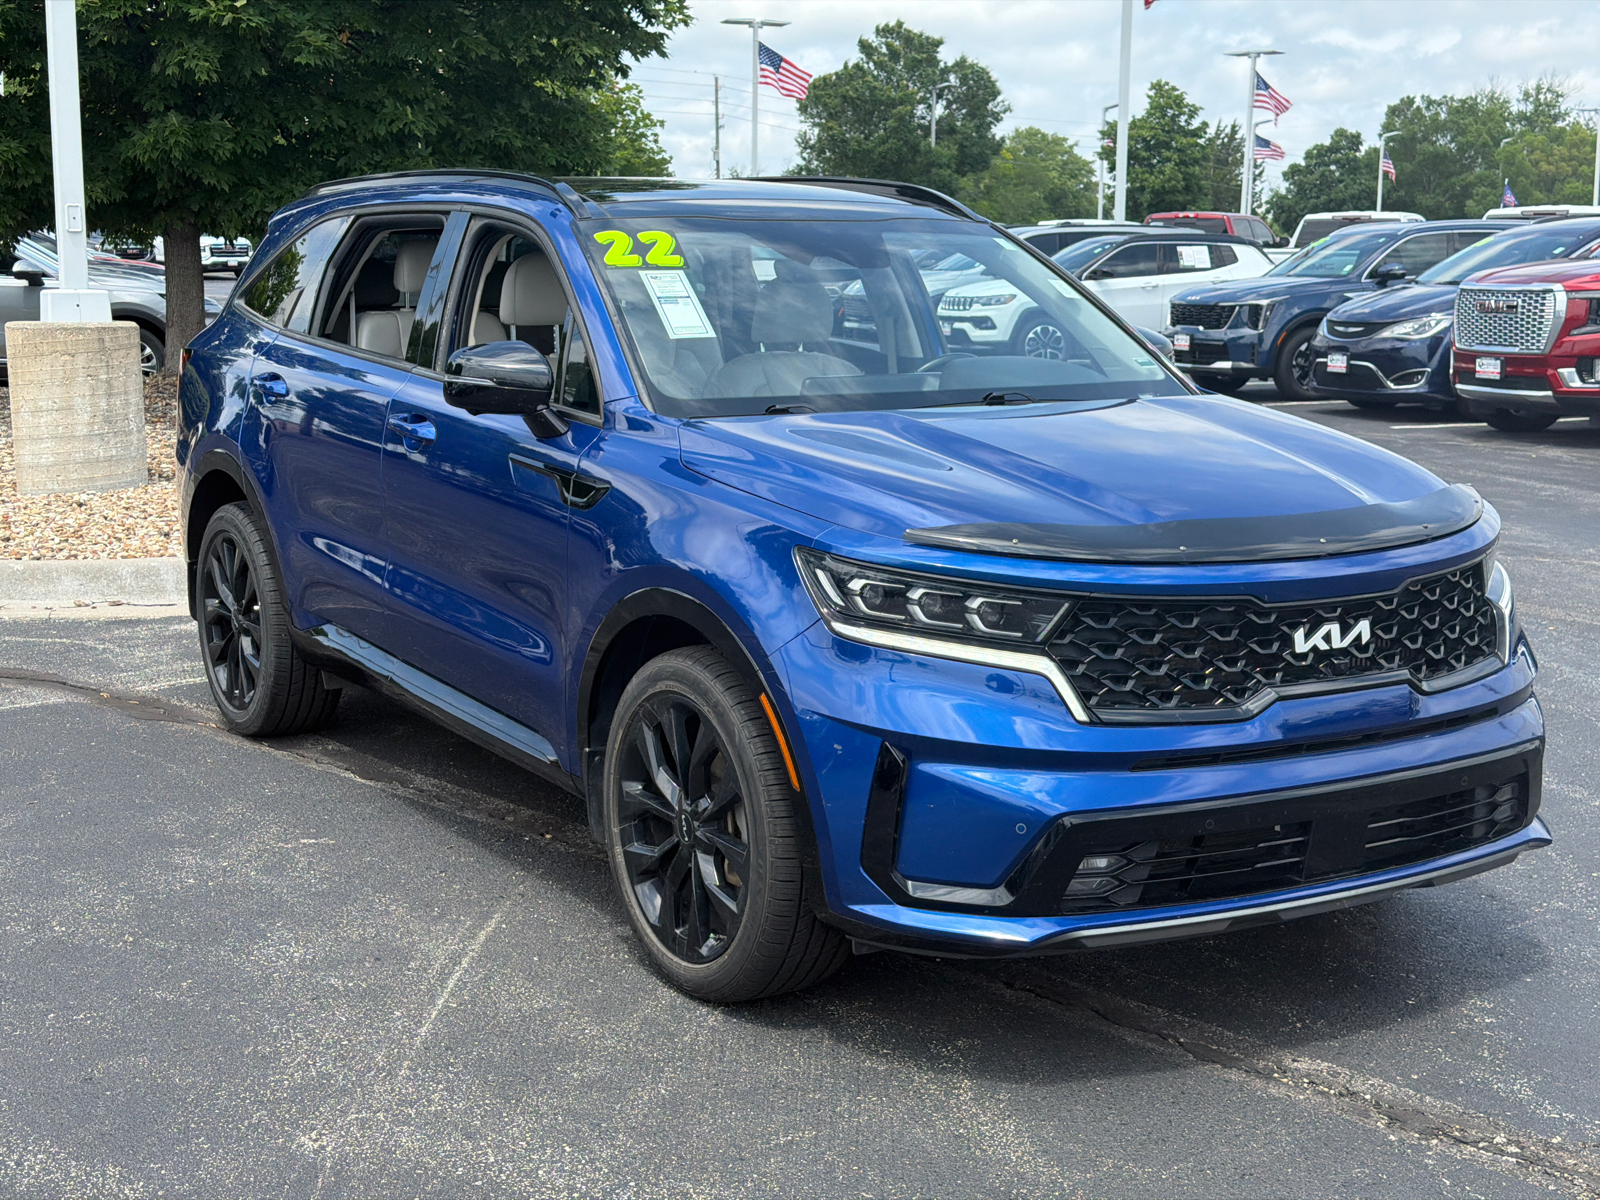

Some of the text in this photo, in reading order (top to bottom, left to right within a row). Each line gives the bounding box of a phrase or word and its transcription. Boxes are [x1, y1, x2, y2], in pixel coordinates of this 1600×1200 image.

[593, 230, 684, 267] 22
[1476, 300, 1518, 314] GMC
[1293, 619, 1371, 654] KIA
